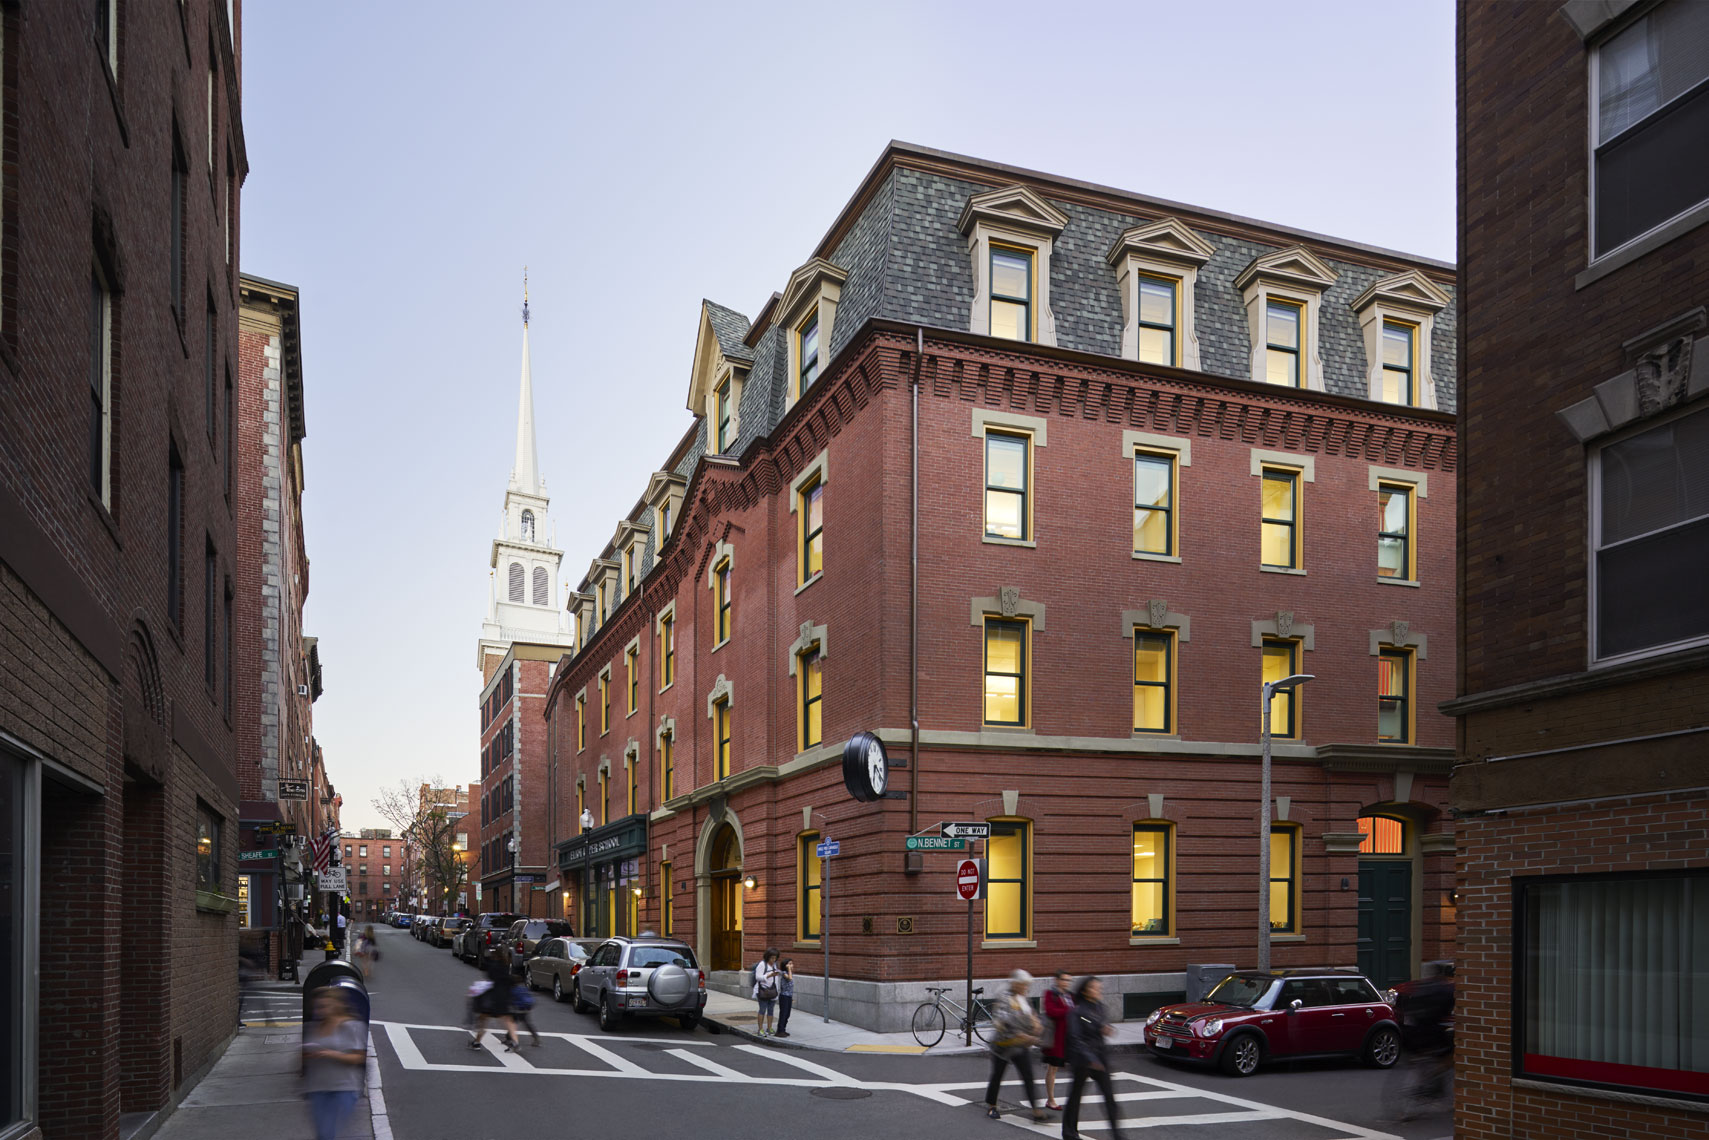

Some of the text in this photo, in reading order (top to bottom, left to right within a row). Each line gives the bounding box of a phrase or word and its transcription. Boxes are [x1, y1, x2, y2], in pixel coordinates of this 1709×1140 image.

[917, 838, 951, 848] N.BENNET
[241, 851, 263, 860] SHEAFE
[961, 884, 974, 892] ENTER
